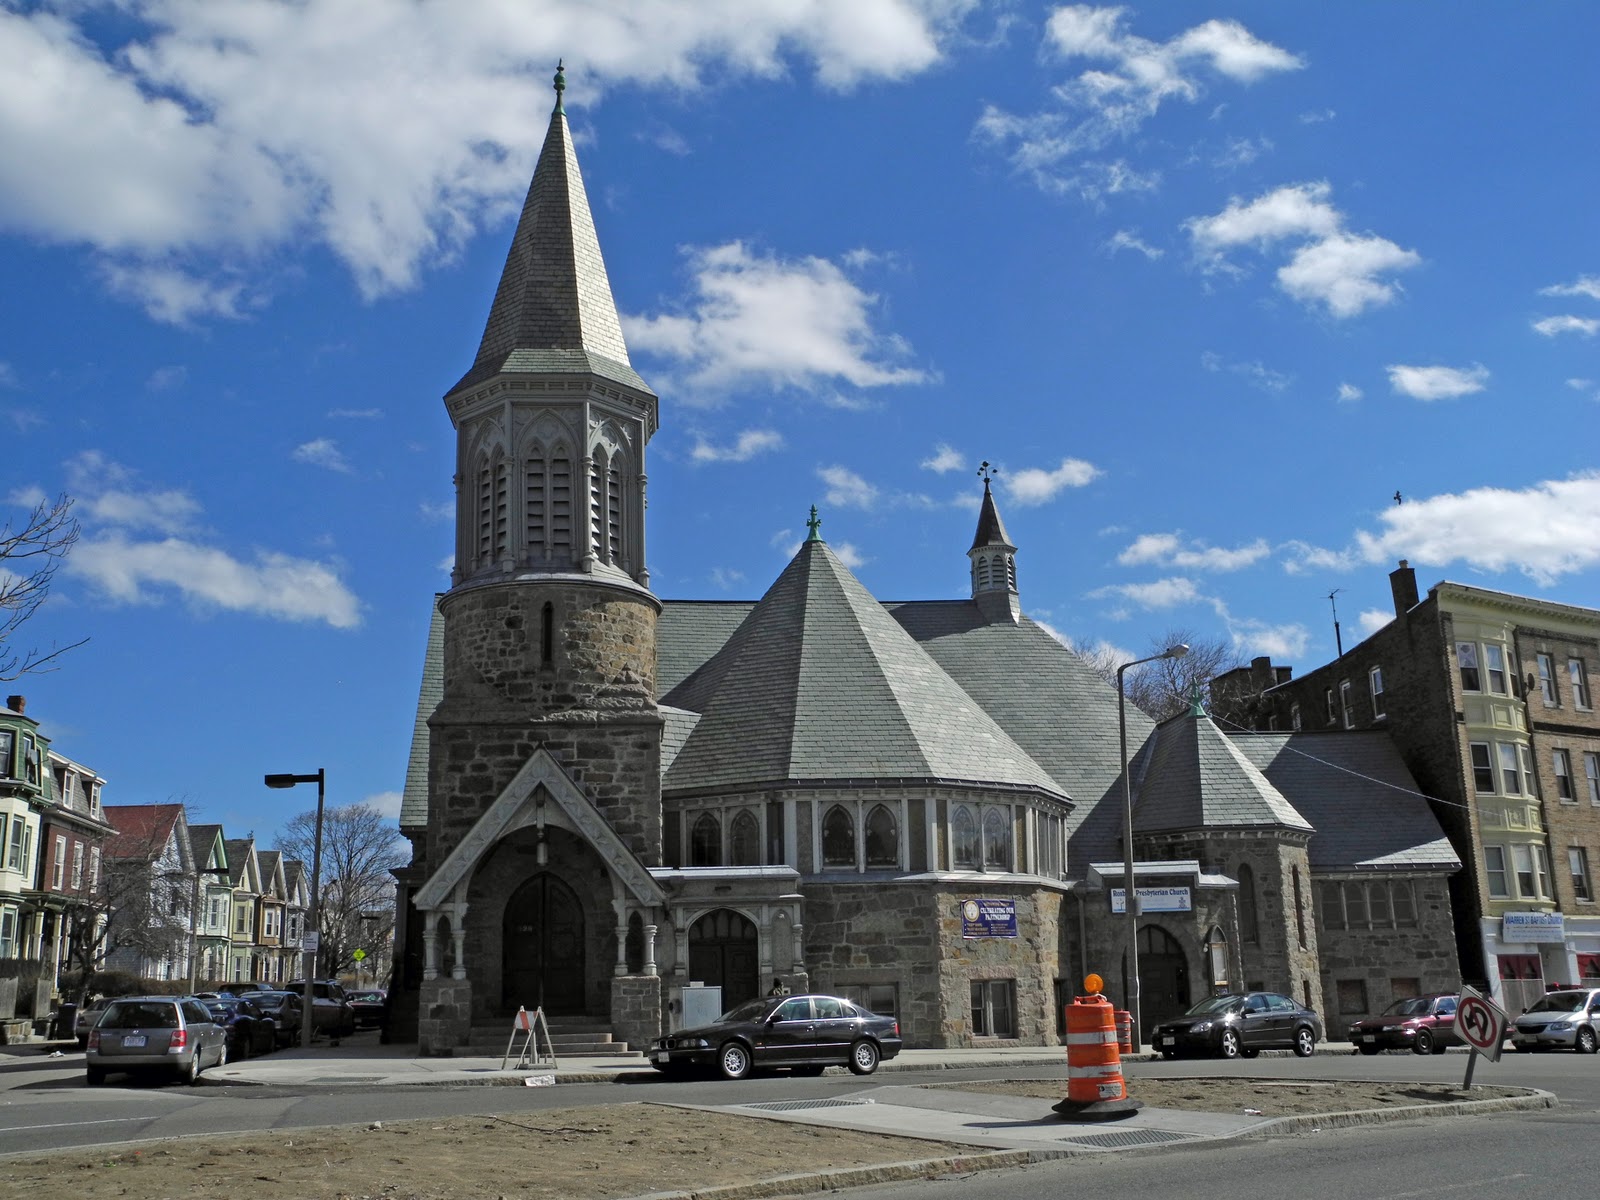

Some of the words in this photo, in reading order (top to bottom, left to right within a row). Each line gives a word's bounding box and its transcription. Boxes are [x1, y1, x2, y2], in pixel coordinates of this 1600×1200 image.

[1136, 889, 1168, 897] Presbyterian
[1169, 888, 1188, 896] Church
[1505, 915, 1524, 924] WARREN
[1548, 915, 1562, 924] CHURCH
